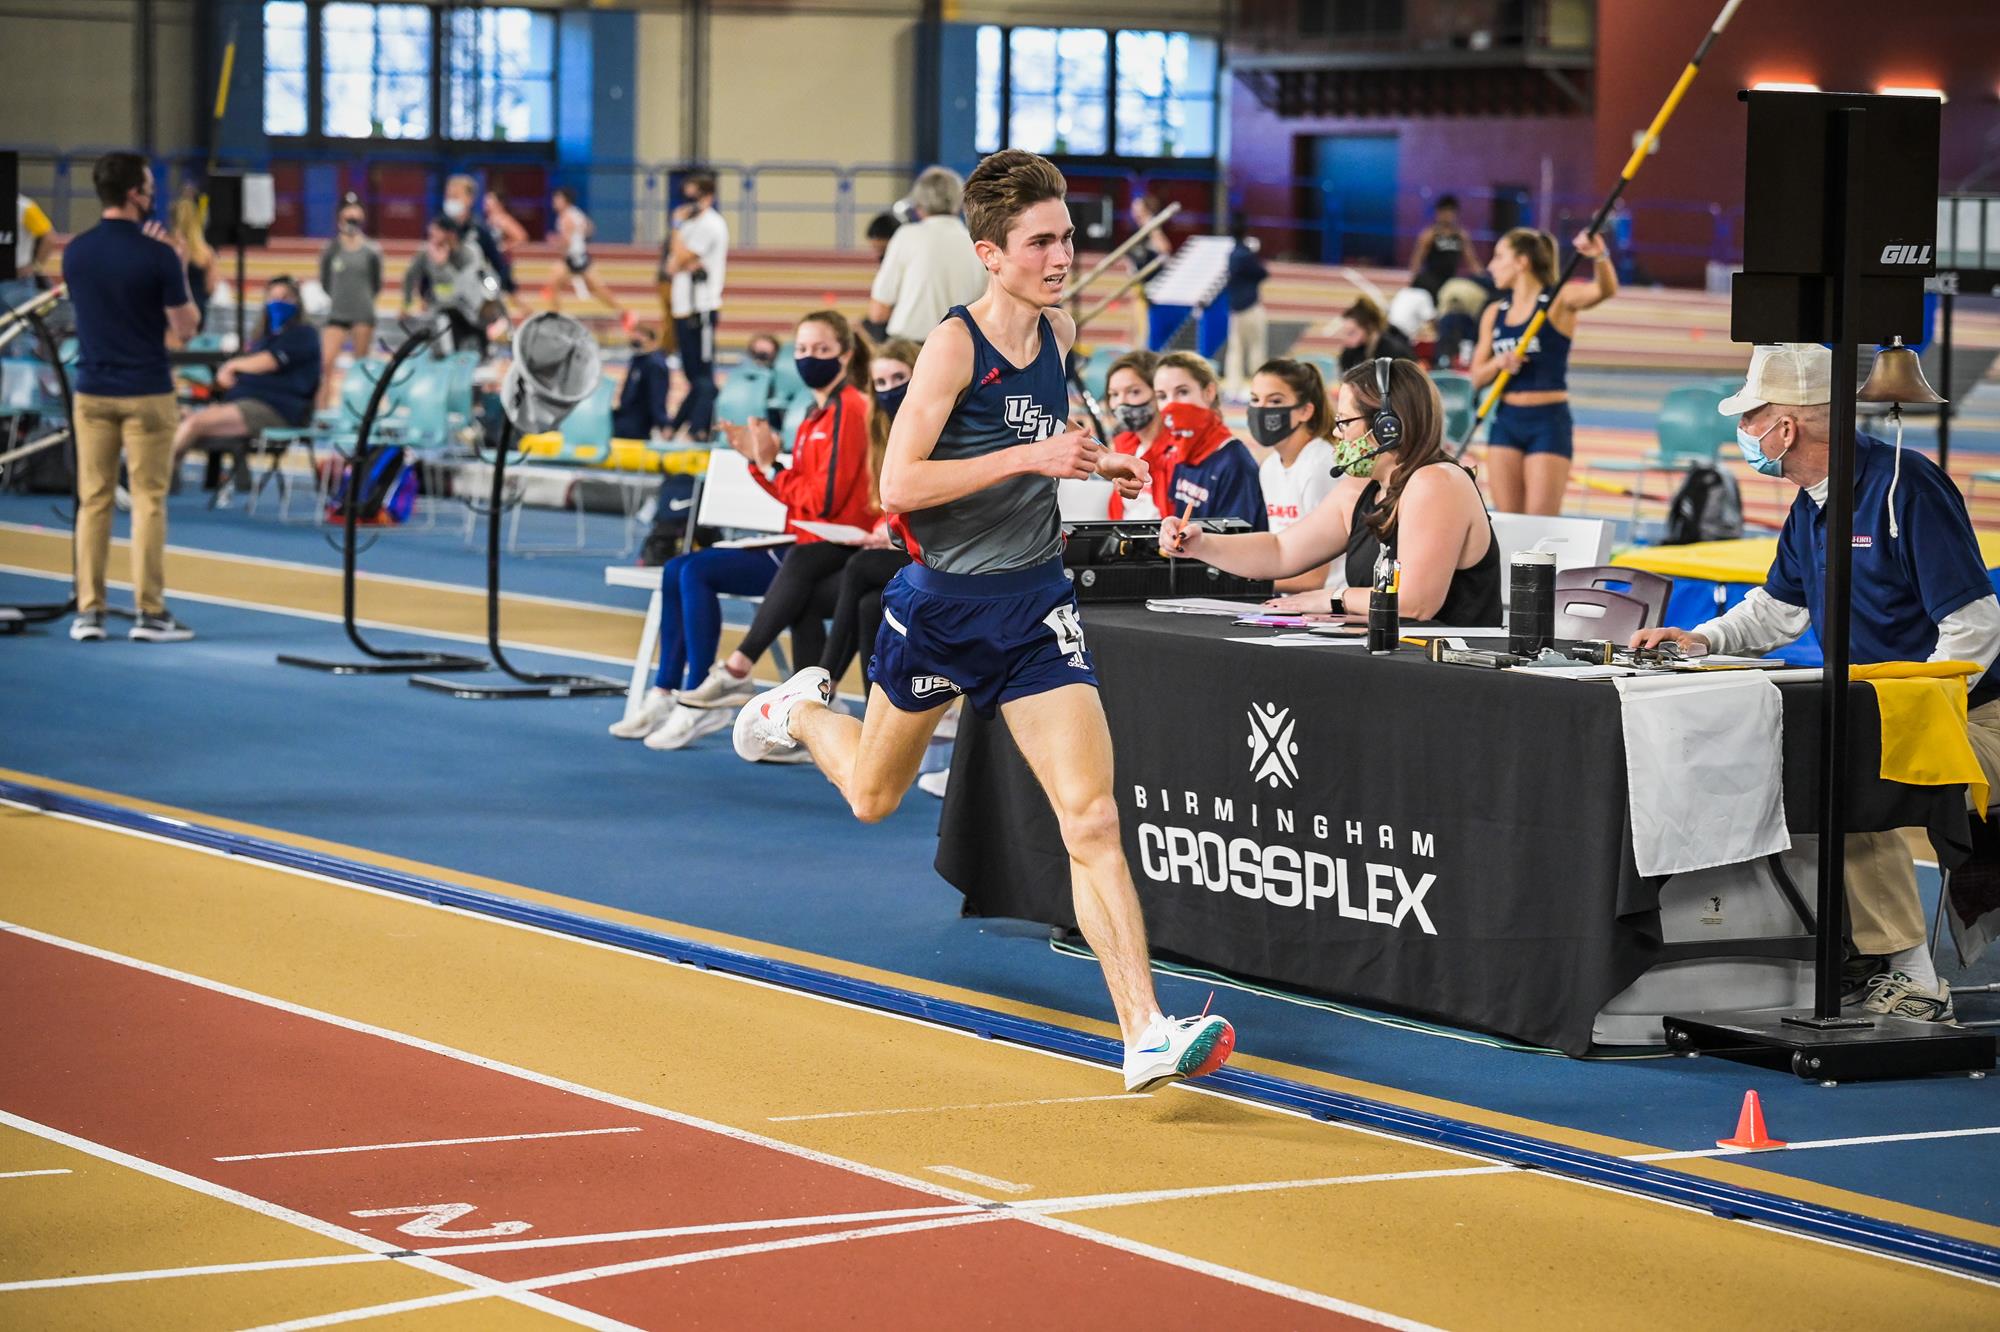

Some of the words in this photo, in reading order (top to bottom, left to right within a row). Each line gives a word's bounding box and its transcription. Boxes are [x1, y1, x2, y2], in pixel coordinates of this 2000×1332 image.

[1881, 245, 1931, 264] GILL
[1134, 784, 1435, 858] BIRMINGHAM
[1138, 823, 1438, 936] CROSSPLEX
[348, 1202, 534, 1238] 2
